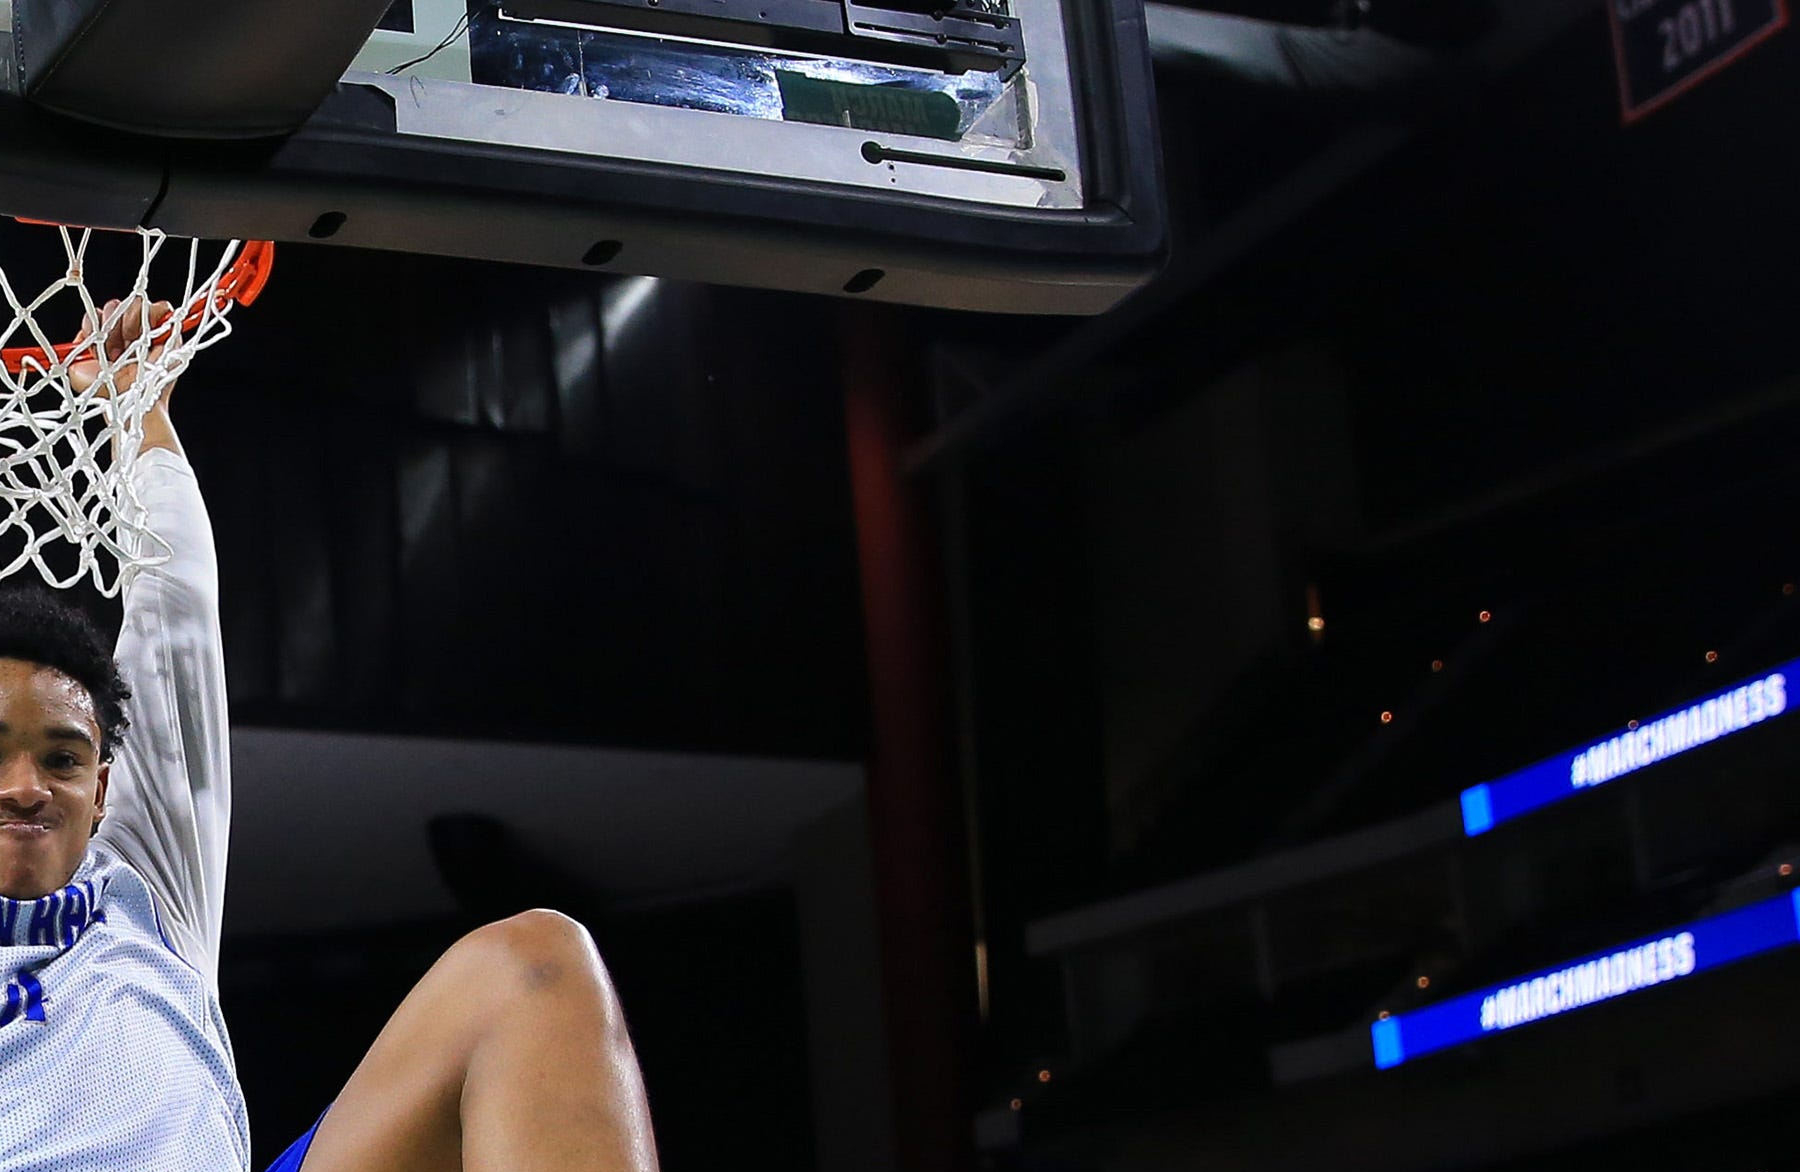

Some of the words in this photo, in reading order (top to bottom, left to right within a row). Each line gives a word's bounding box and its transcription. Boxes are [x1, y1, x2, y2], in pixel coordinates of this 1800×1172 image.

[1657, 0, 1737, 74] 2011
[1570, 673, 1787, 789] #MARCHMADNESS
[1479, 931, 1696, 1031] #MARCHMADNESS
